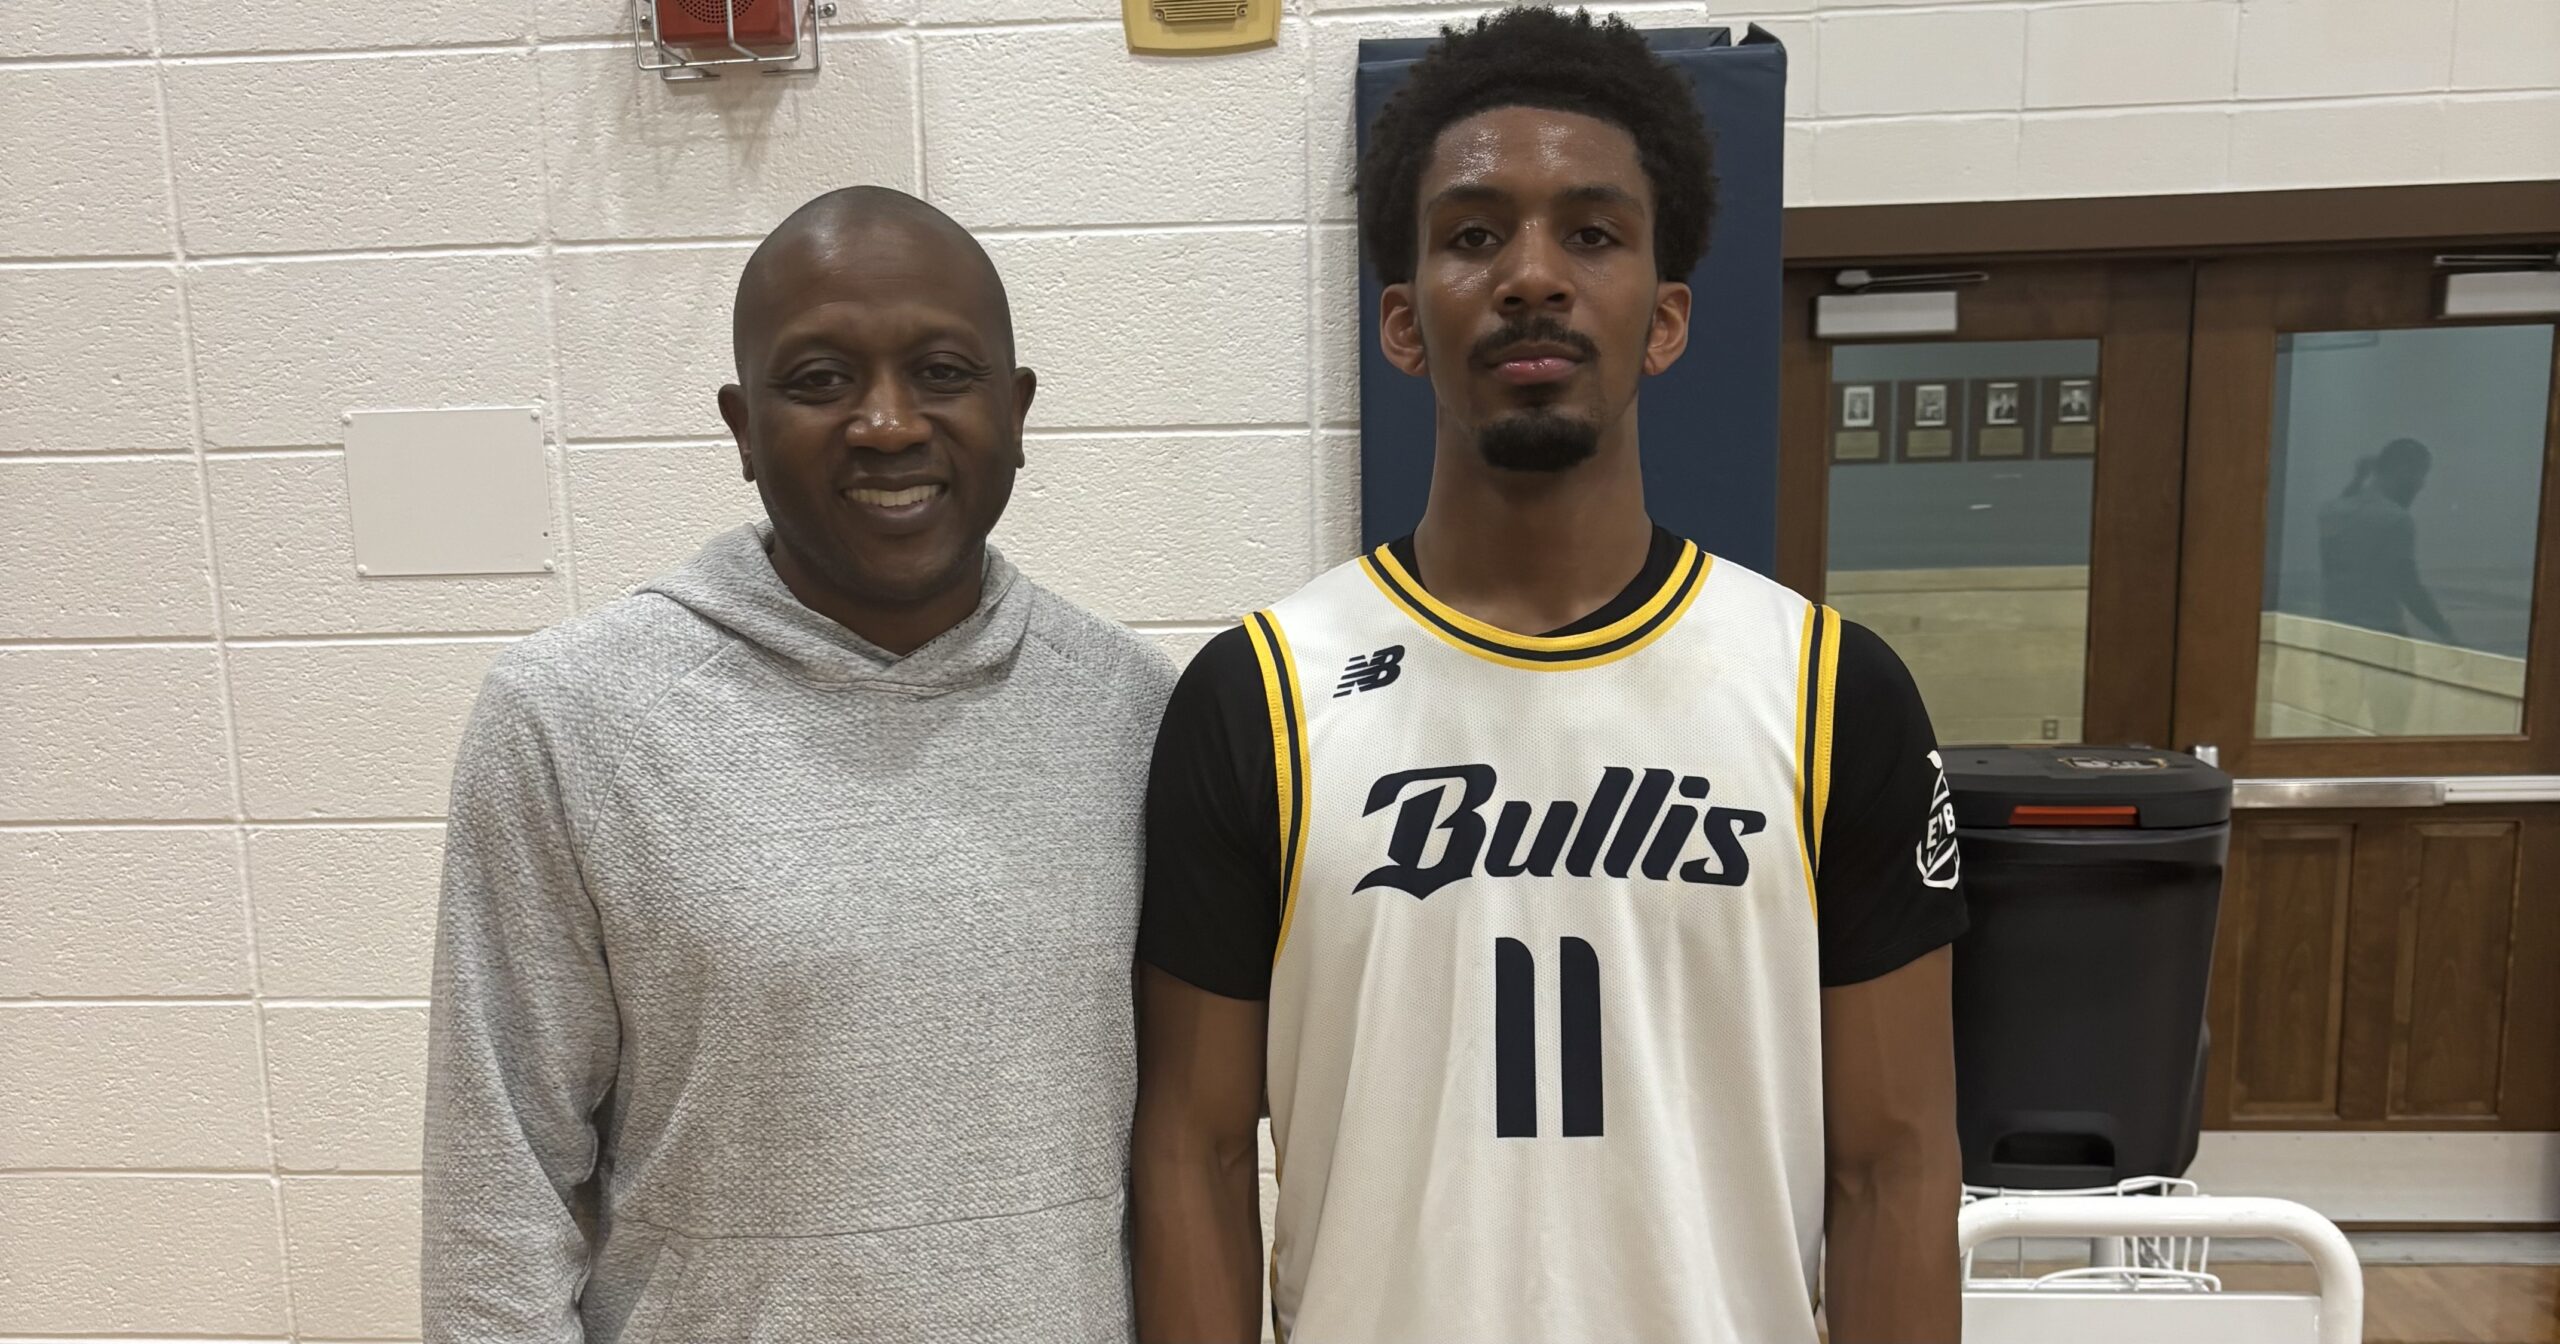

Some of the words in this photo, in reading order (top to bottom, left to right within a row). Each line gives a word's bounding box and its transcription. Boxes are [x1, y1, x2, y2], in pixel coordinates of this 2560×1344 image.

[1333, 644, 1405, 699] NB
[1352, 764, 1767, 900] Bullis
[1495, 936, 1604, 1139] 11
